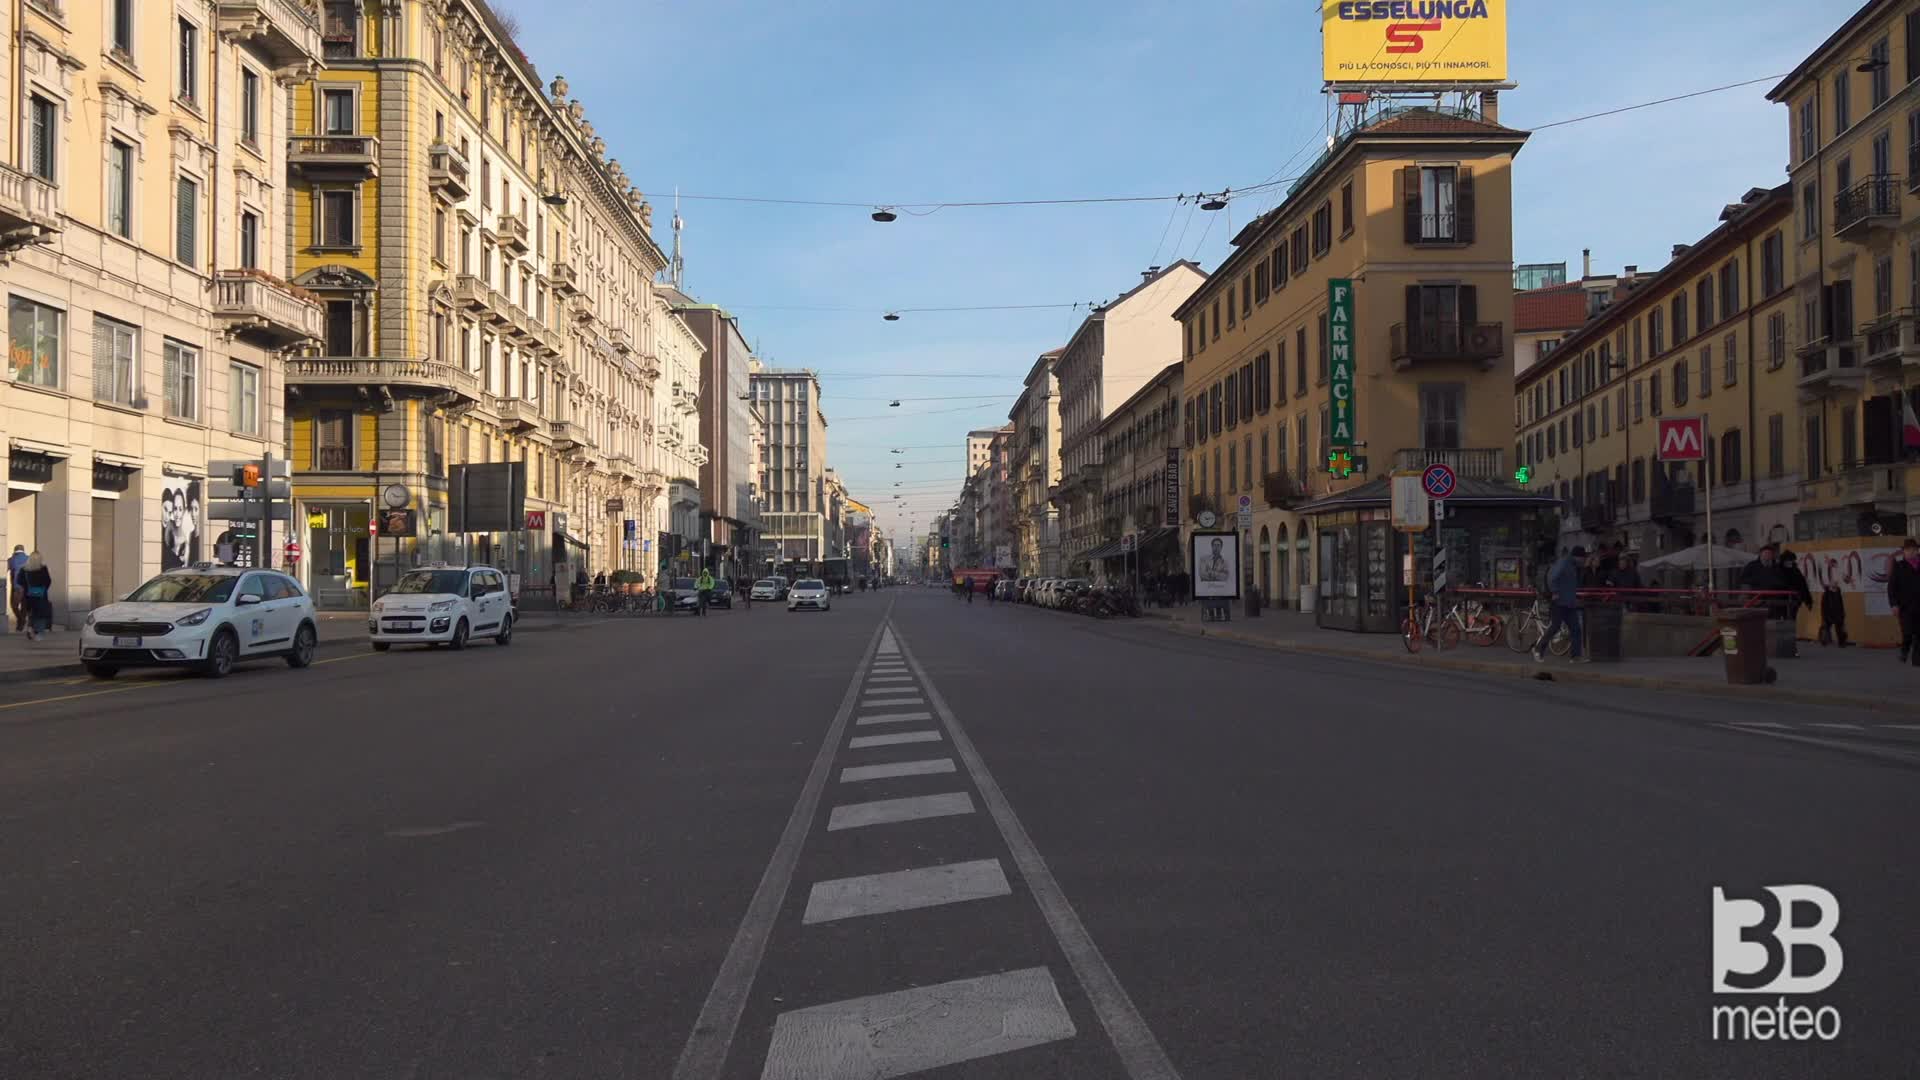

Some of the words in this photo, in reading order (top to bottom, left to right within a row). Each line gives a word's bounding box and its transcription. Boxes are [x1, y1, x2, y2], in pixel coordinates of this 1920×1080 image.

[1338, 0, 1489, 20] ESSELUNGA
[1339, 61, 1353, 70] PIÙ
[1370, 62, 1413, 70] CONOSCI,
[1416, 61, 1430, 69] PIÙ
[1443, 61, 1491, 69] INNAMORI.
[1332, 286, 1350, 438] FARMACIA
[1662, 425, 1700, 453] M
[528, 515, 543, 527] M
